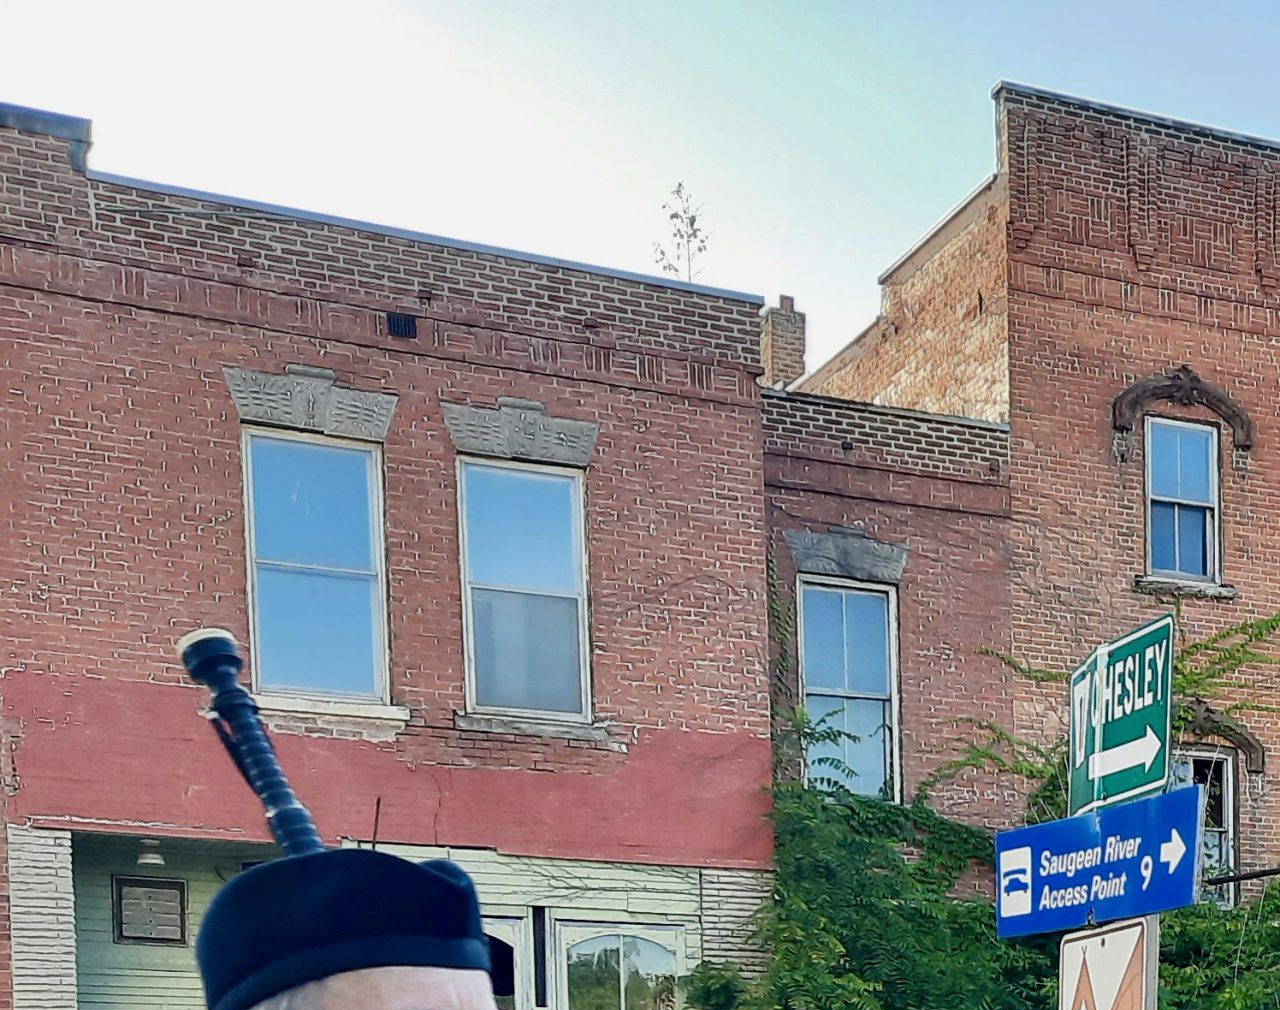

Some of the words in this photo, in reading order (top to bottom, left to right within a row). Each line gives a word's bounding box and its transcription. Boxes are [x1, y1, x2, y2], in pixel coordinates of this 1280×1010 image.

[1090, 639, 1167, 728] CHESLEY
[1039, 847, 1102, 878] Saugeen
[1104, 835, 1142, 863] River
[1140, 854, 1153, 891] 9
[1038, 884, 1088, 911] Access
[1090, 870, 1128, 902] Point
